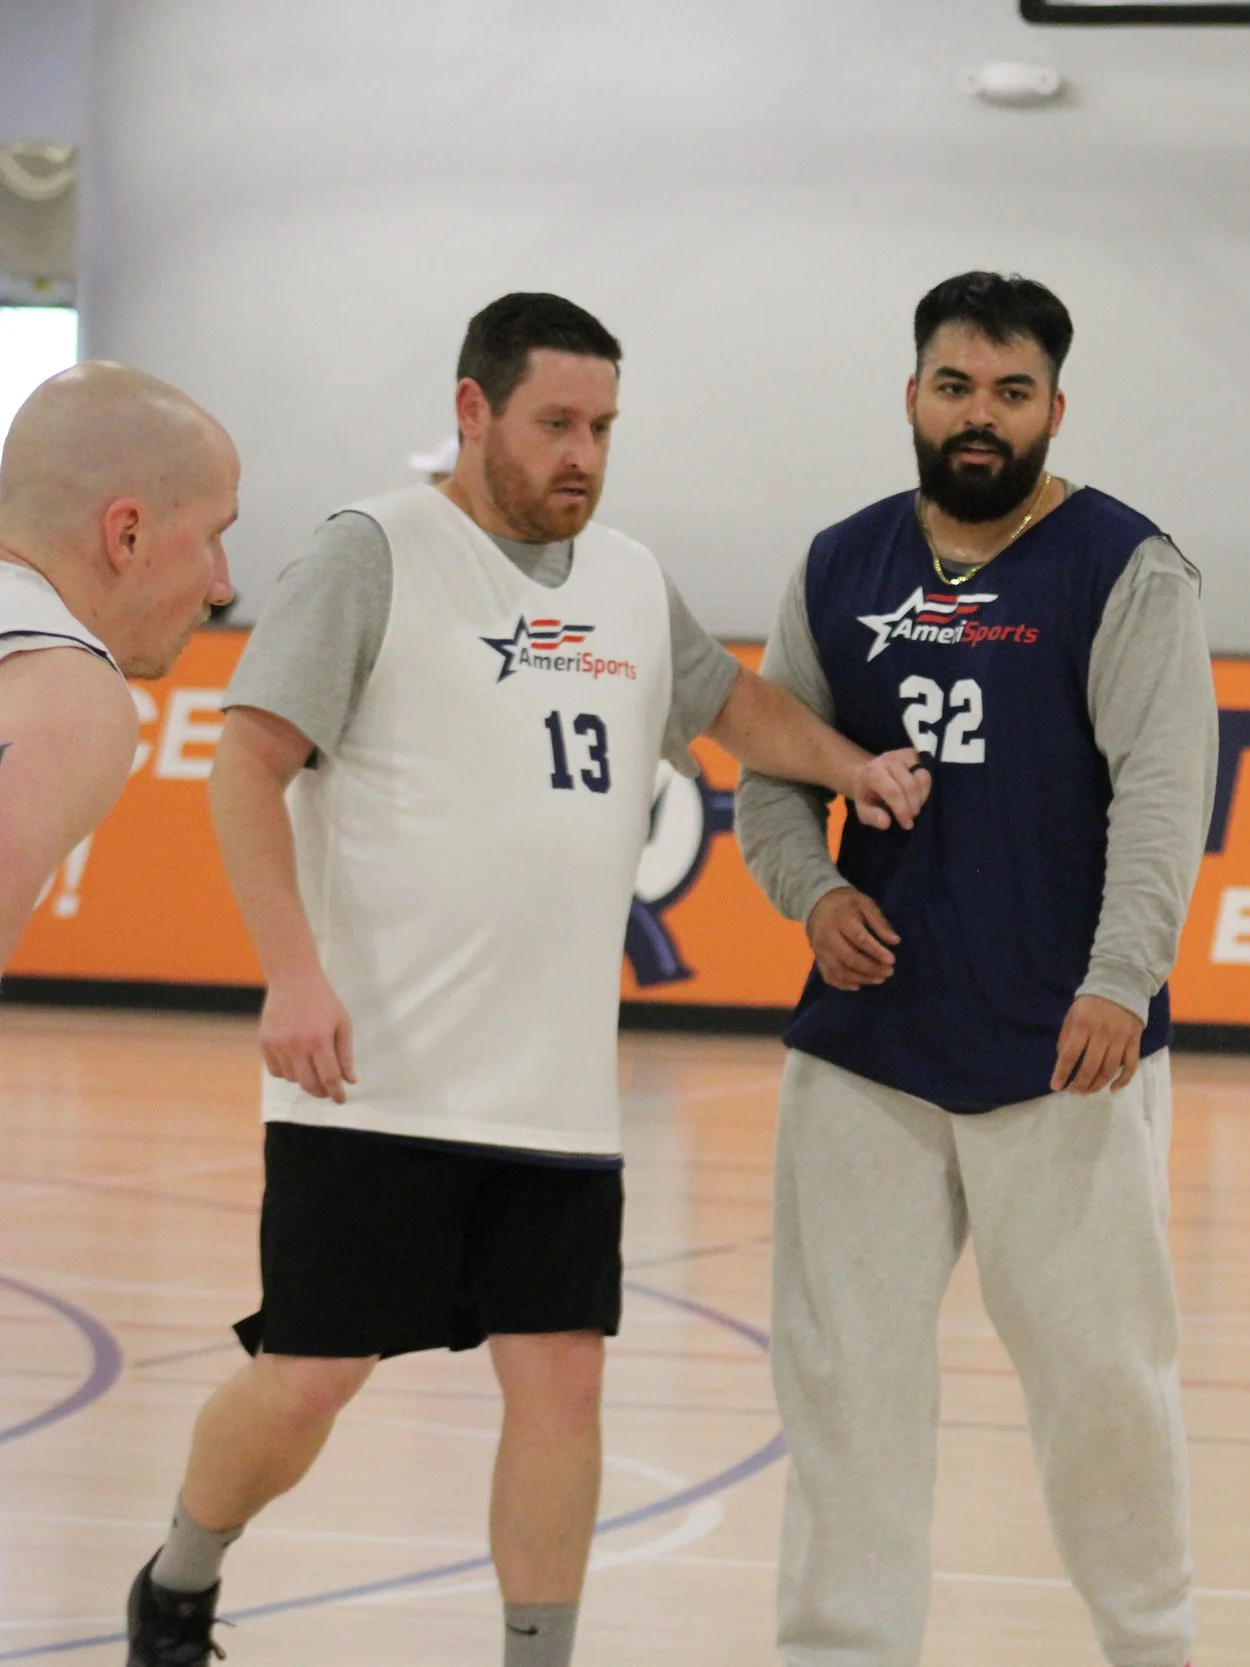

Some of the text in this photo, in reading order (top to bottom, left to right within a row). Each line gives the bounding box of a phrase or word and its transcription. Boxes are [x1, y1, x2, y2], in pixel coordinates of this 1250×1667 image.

[891, 617, 1041, 648] AmeriSports
[518, 647, 638, 681] AmeriSports
[899, 674, 987, 765] 22
[544, 710, 612, 795] 13
